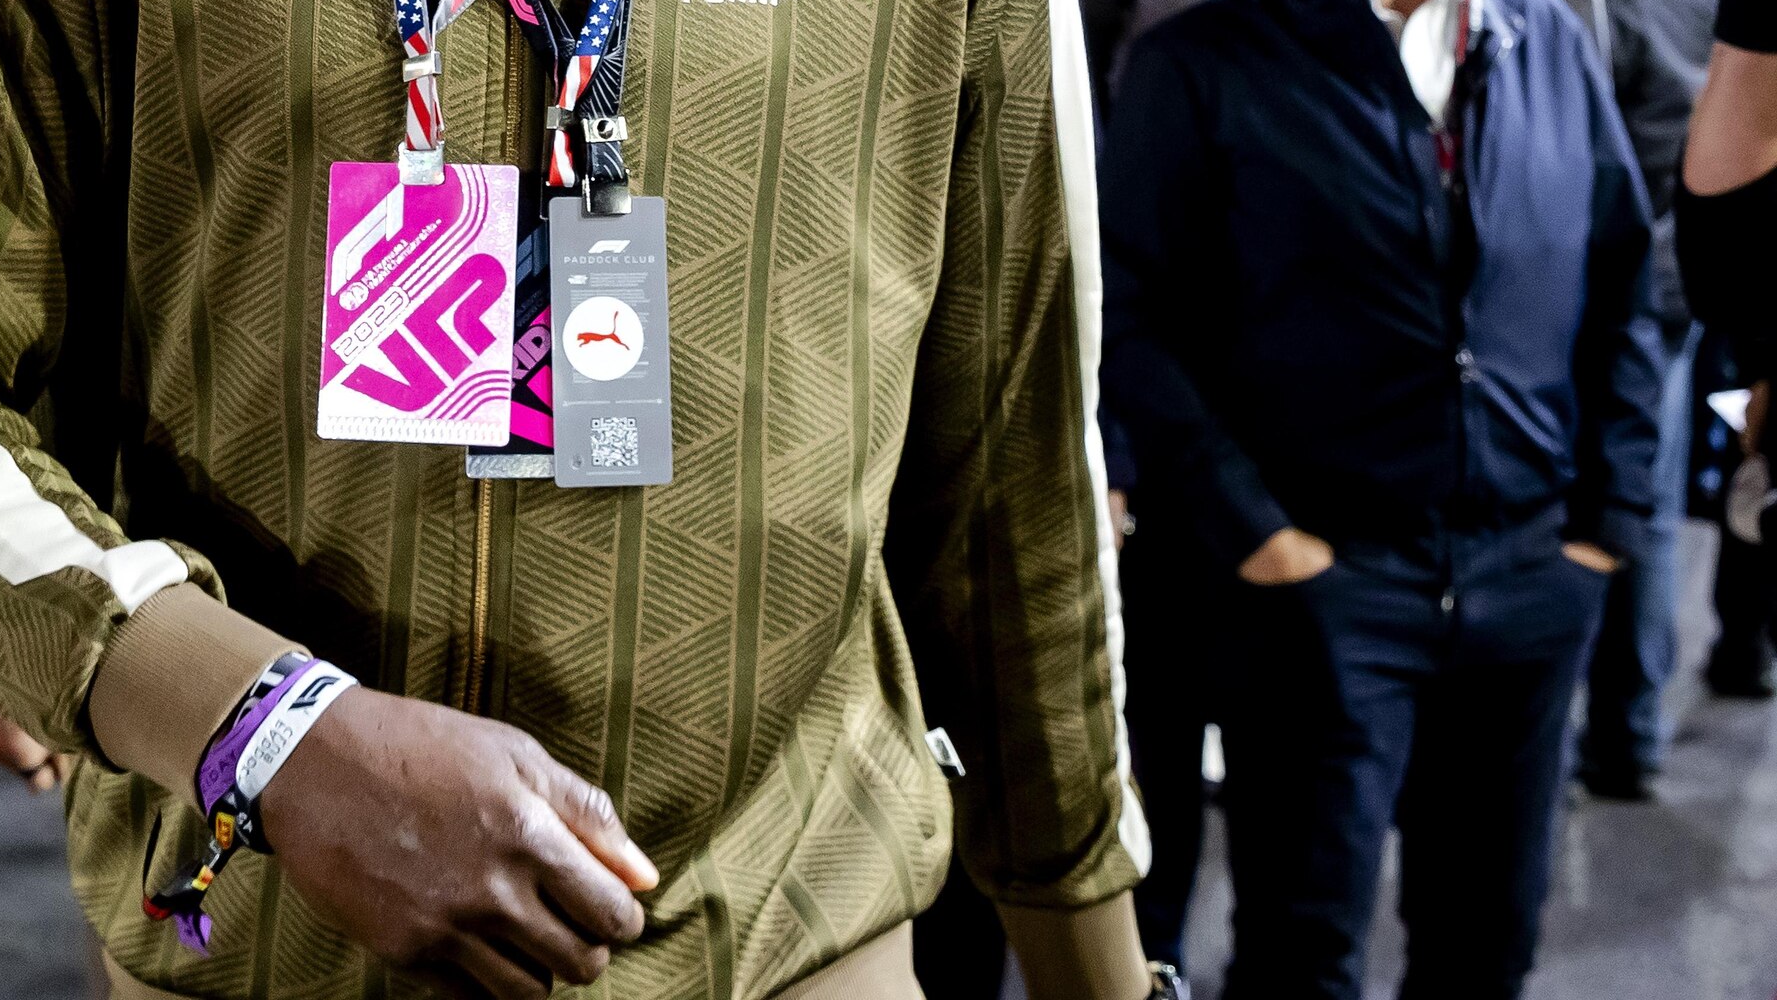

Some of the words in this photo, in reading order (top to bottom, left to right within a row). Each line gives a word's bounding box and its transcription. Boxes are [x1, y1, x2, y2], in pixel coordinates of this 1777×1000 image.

[564, 256, 620, 264] PADDOCK
[625, 255, 655, 264] CLUB
[340, 291, 405, 358] 2023
[341, 253, 507, 411] VIP
